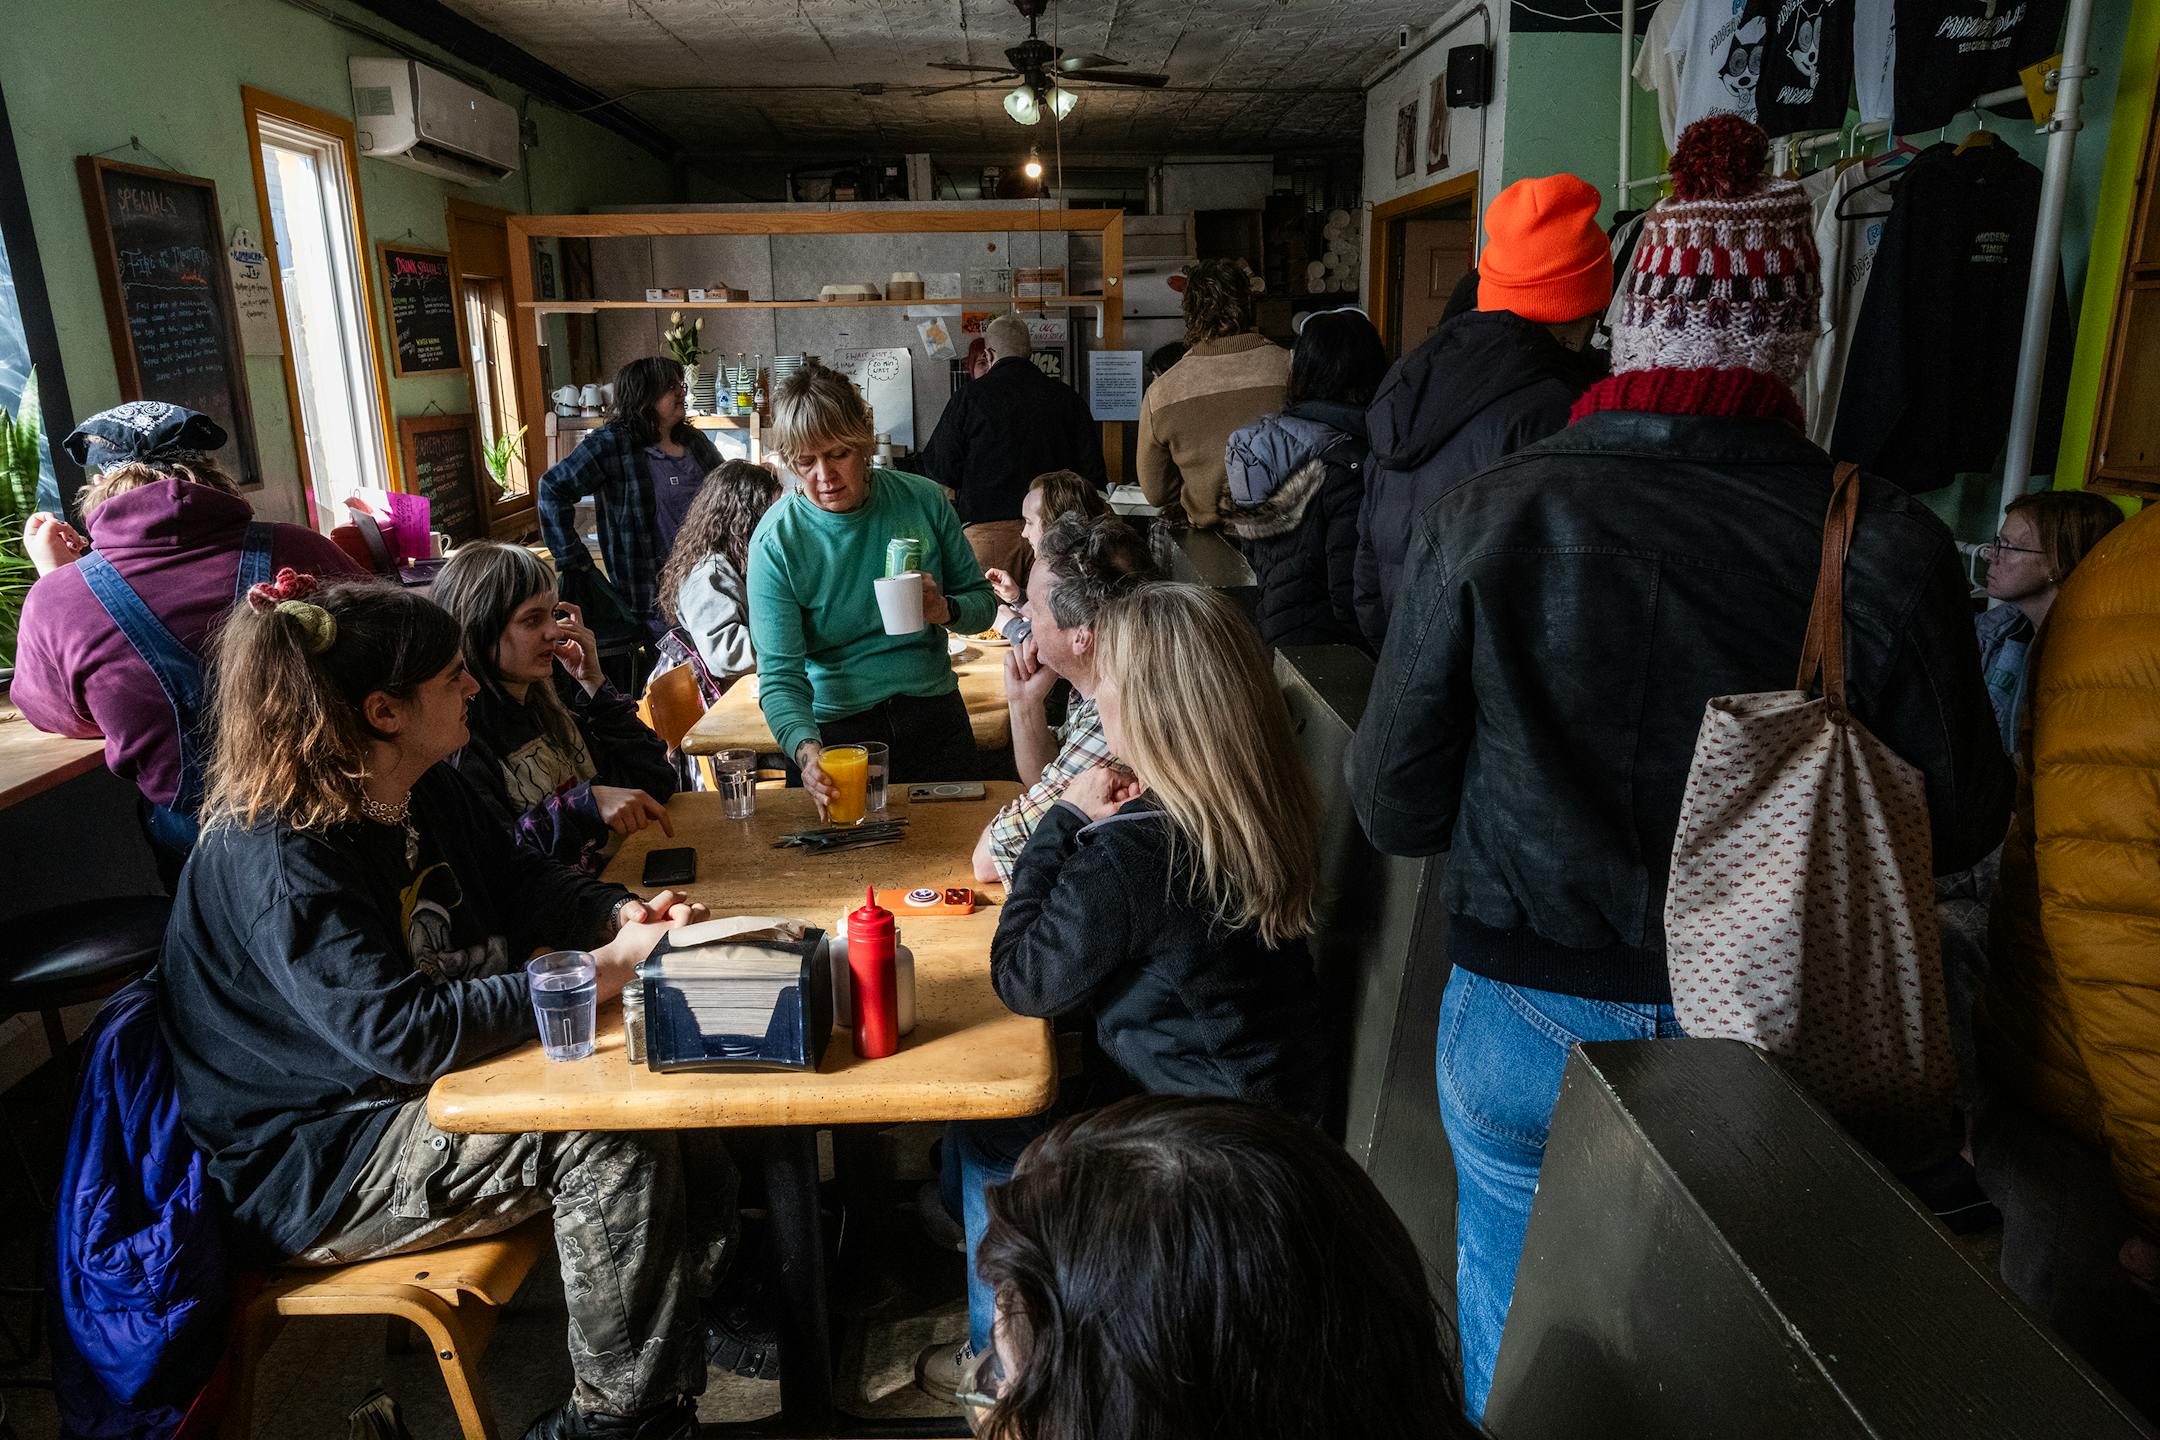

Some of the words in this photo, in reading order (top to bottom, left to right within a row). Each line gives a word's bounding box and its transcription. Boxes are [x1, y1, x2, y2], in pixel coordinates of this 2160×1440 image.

[118, 187, 177, 215] SPECIALS
[1975, 231, 2010, 243] MODERN
[396, 256, 418, 276] DRINK
[851, 351, 869, 360] WAIT
